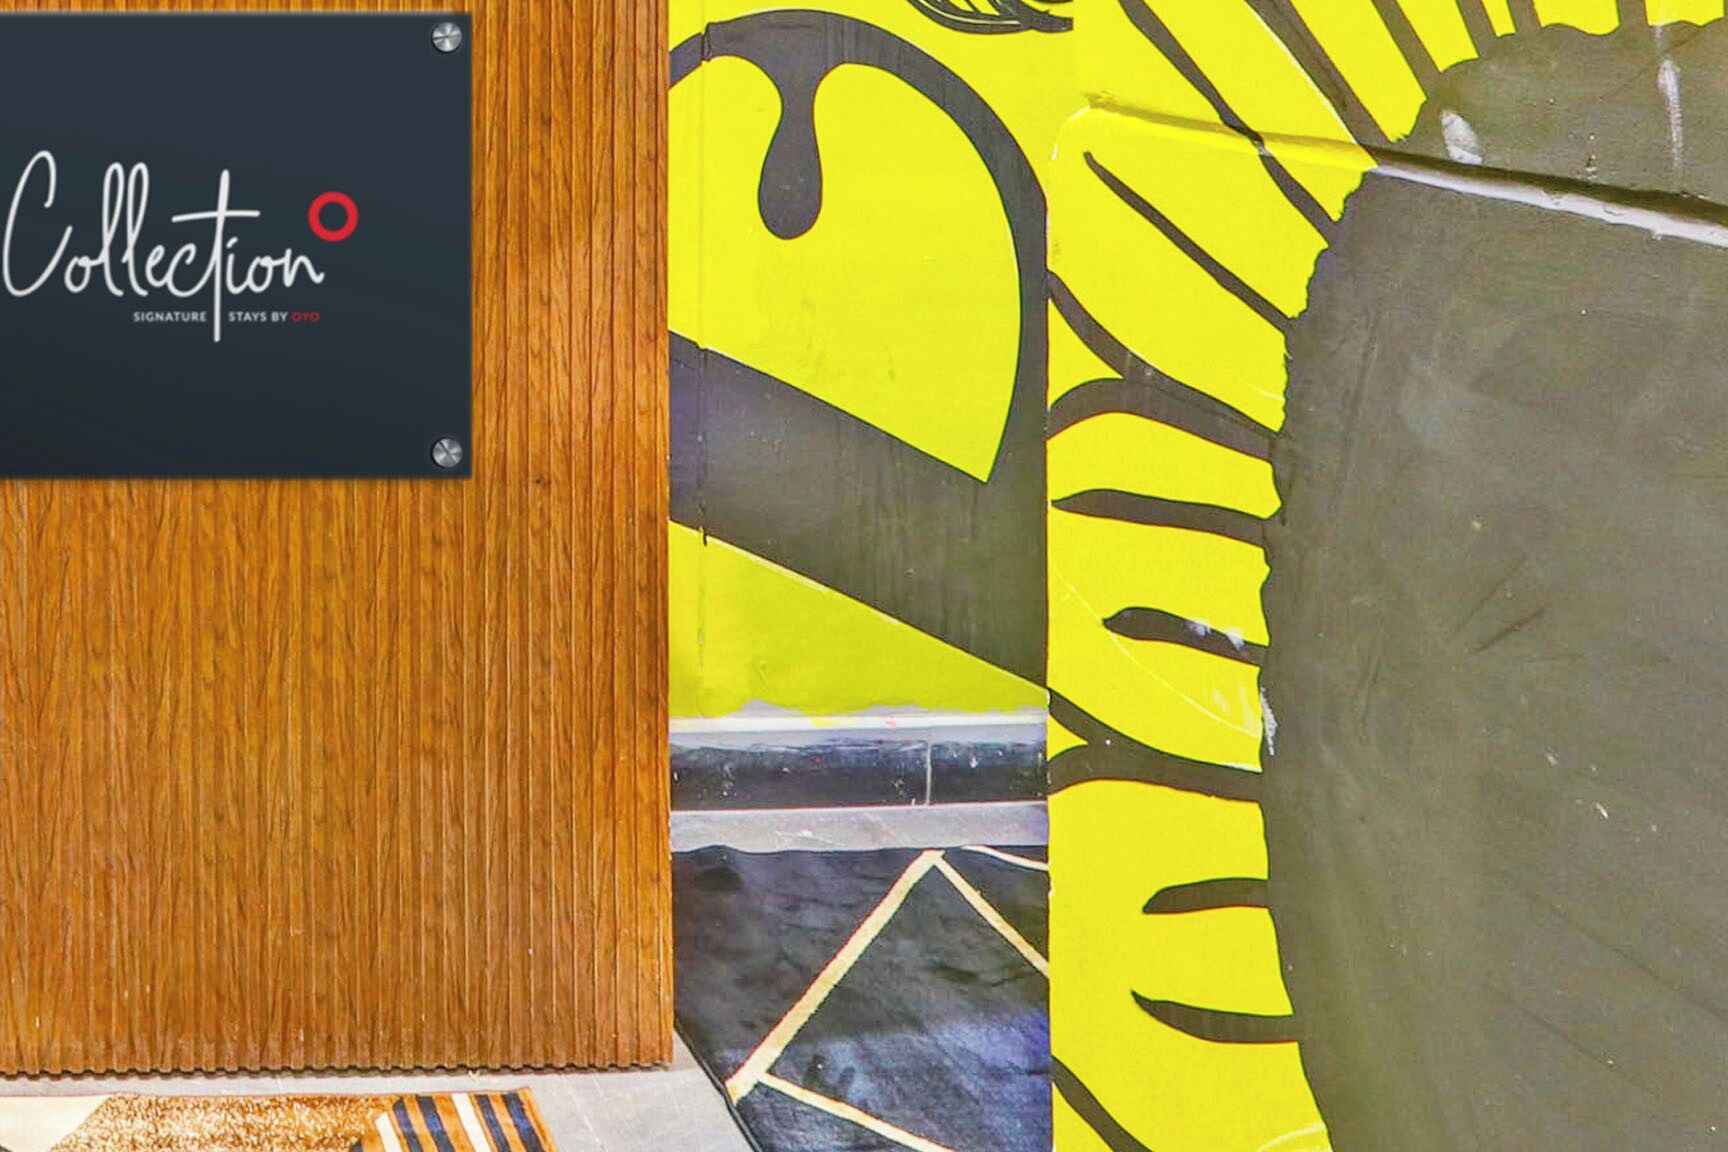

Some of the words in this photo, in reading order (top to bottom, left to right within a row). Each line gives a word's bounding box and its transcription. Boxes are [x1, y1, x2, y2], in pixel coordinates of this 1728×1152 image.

[3, 150, 325, 343] Collection
[133, 311, 207, 322] SIGNATURE
[228, 311, 267, 322] STAYS
[271, 311, 288, 322] BY
[291, 311, 320, 322] OYO
